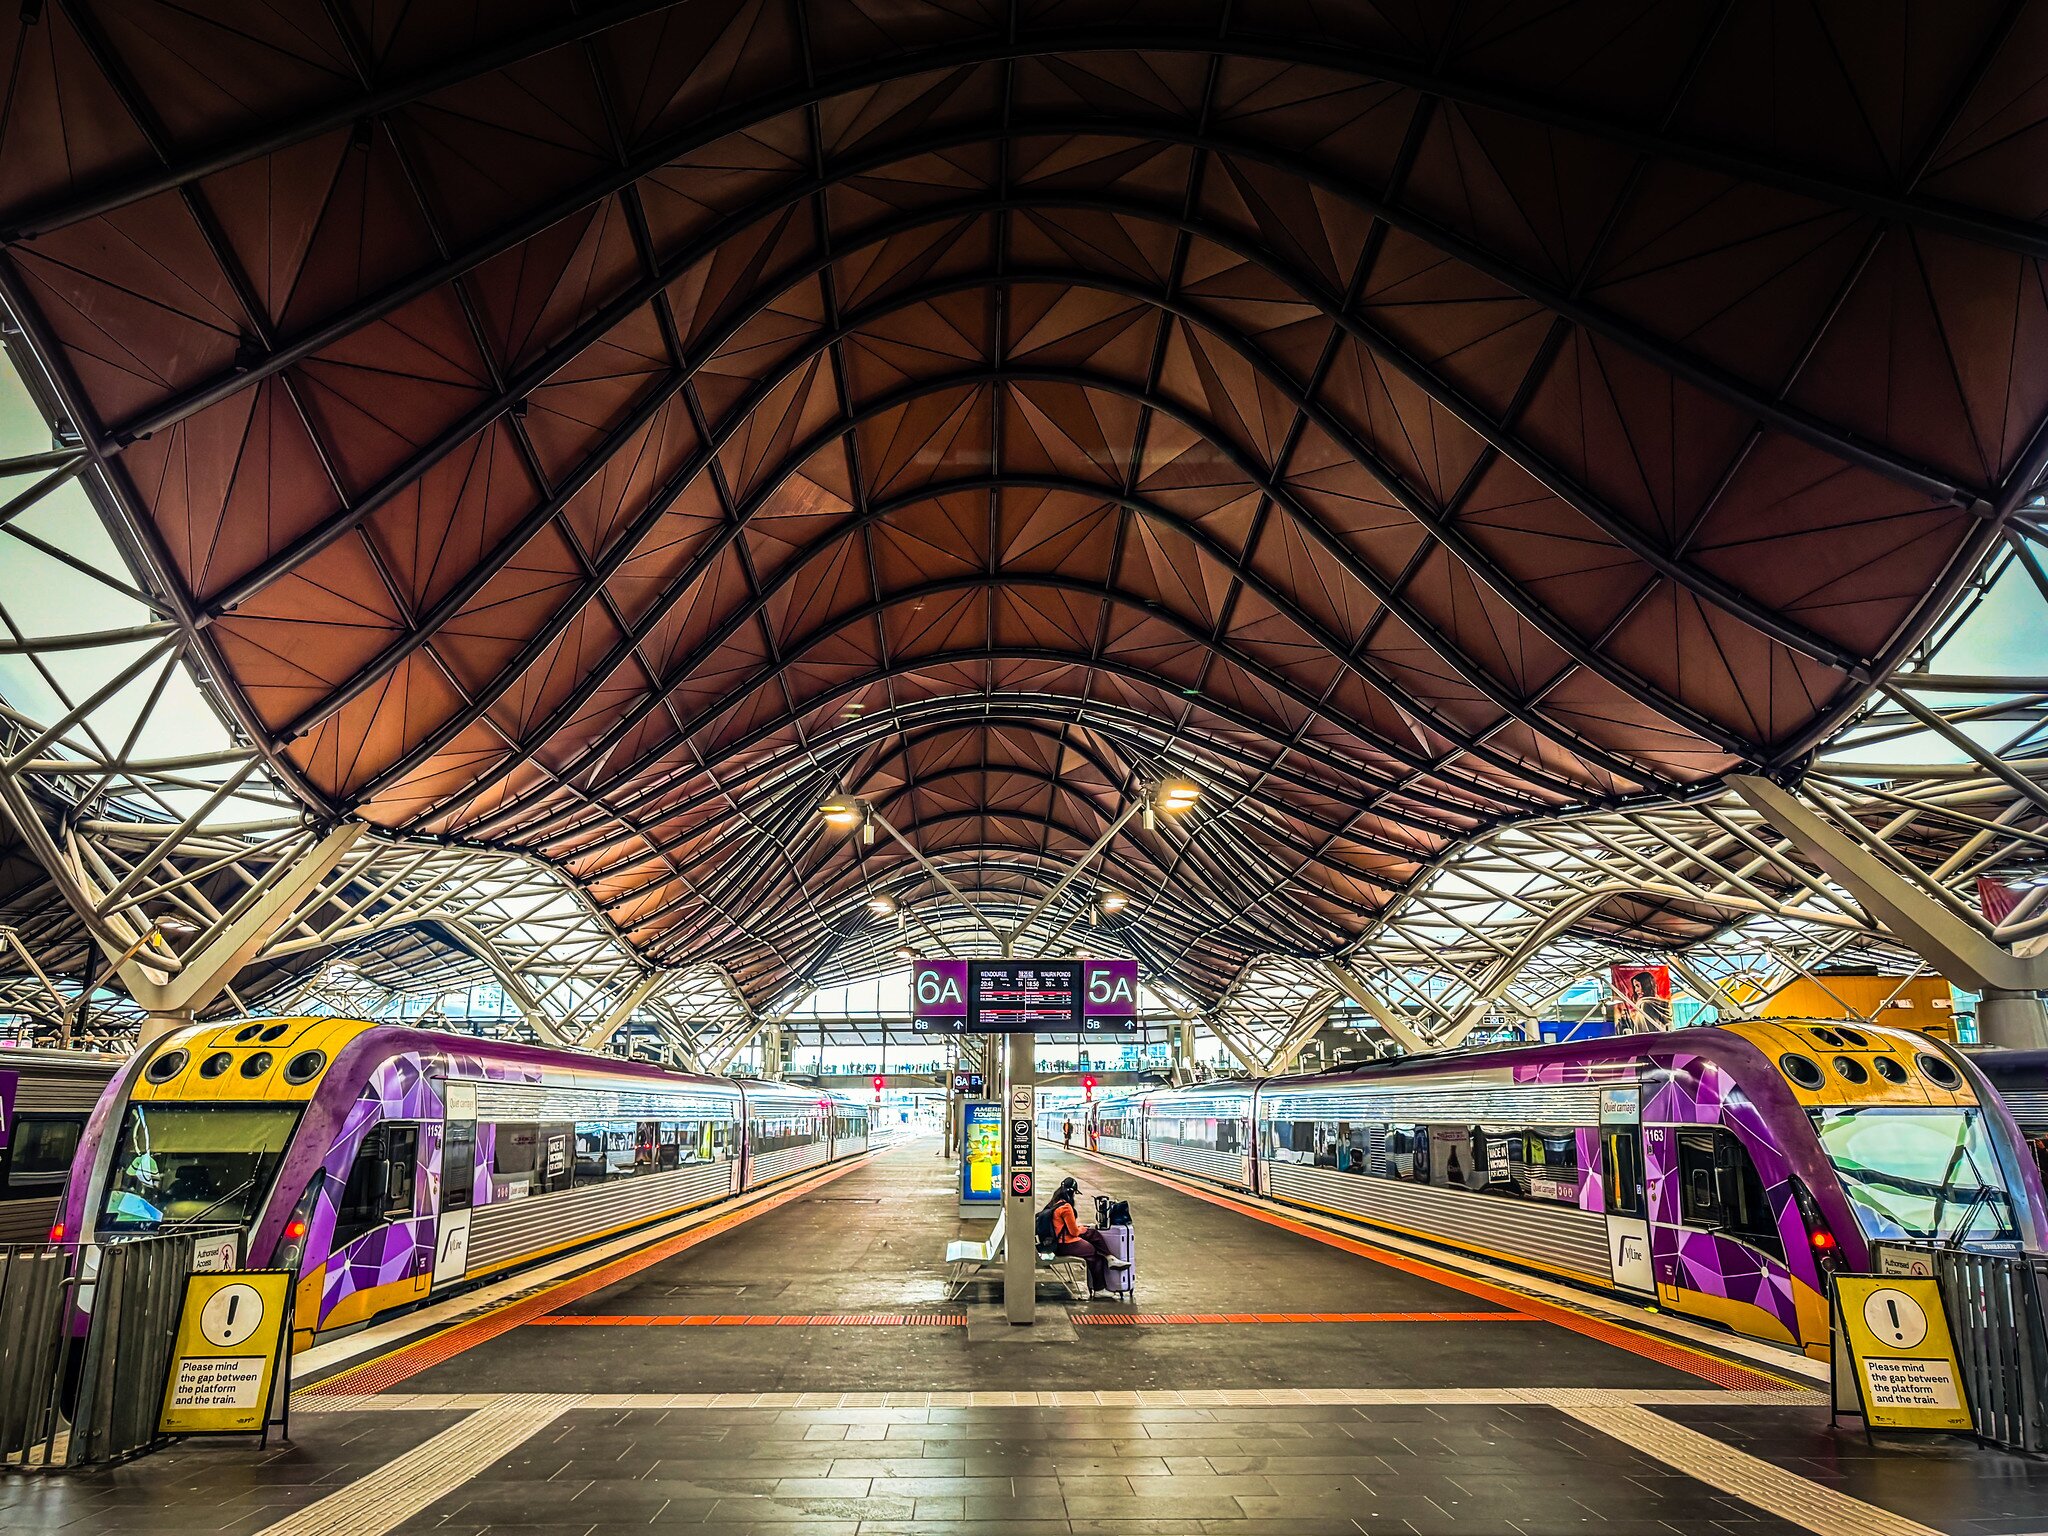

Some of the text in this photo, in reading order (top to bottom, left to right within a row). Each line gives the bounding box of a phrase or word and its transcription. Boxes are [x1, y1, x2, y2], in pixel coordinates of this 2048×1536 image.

[917, 970, 962, 1004] 6A
[1088, 970, 1133, 1004] 5A
[915, 1018, 928, 1030] 6B
[1086, 1018, 1100, 1030] 5B
[955, 1075, 969, 1086] 6A
[1604, 1102, 1636, 1114] Quiet carriage
[427, 1124, 442, 1137] 1152
[1646, 1129, 1664, 1142] 1163
[182, 1362, 239, 1371] Please mind
[1868, 1362, 1925, 1372] Please mind
[181, 1373, 257, 1384] the gap between
[1872, 1373, 1949, 1384] the gap between
[178, 1384, 236, 1395] the platform
[1874, 1384, 1933, 1394] the platform
[175, 1395, 236, 1405] and the train.
[1877, 1394, 1939, 1405] and the train.
